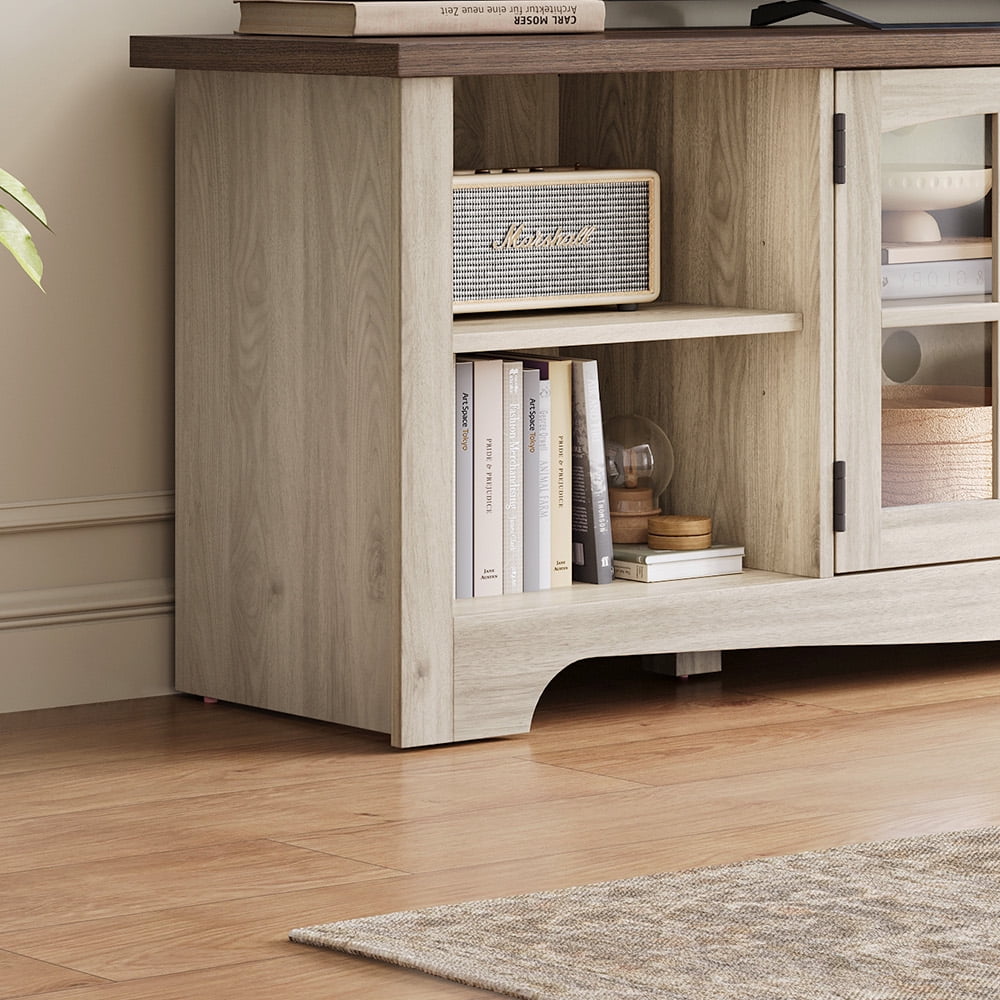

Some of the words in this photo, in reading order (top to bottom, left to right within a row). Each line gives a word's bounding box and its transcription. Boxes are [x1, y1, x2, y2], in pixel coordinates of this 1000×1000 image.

[441, 5, 459, 16] Zeit
[462, 5, 485, 14] neue
[487, 5, 507, 14] eine
[509, 5, 524, 15] für
[525, 5, 578, 14] Architektur
[513, 15, 549, 25] MOSER
[551, 15, 577, 24] CARL
[493, 223, 598, 250] Marshall
[509, 402, 520, 439] Fashion
[528, 410, 536, 431] Space
[505, 441, 520, 511] Merchandising
